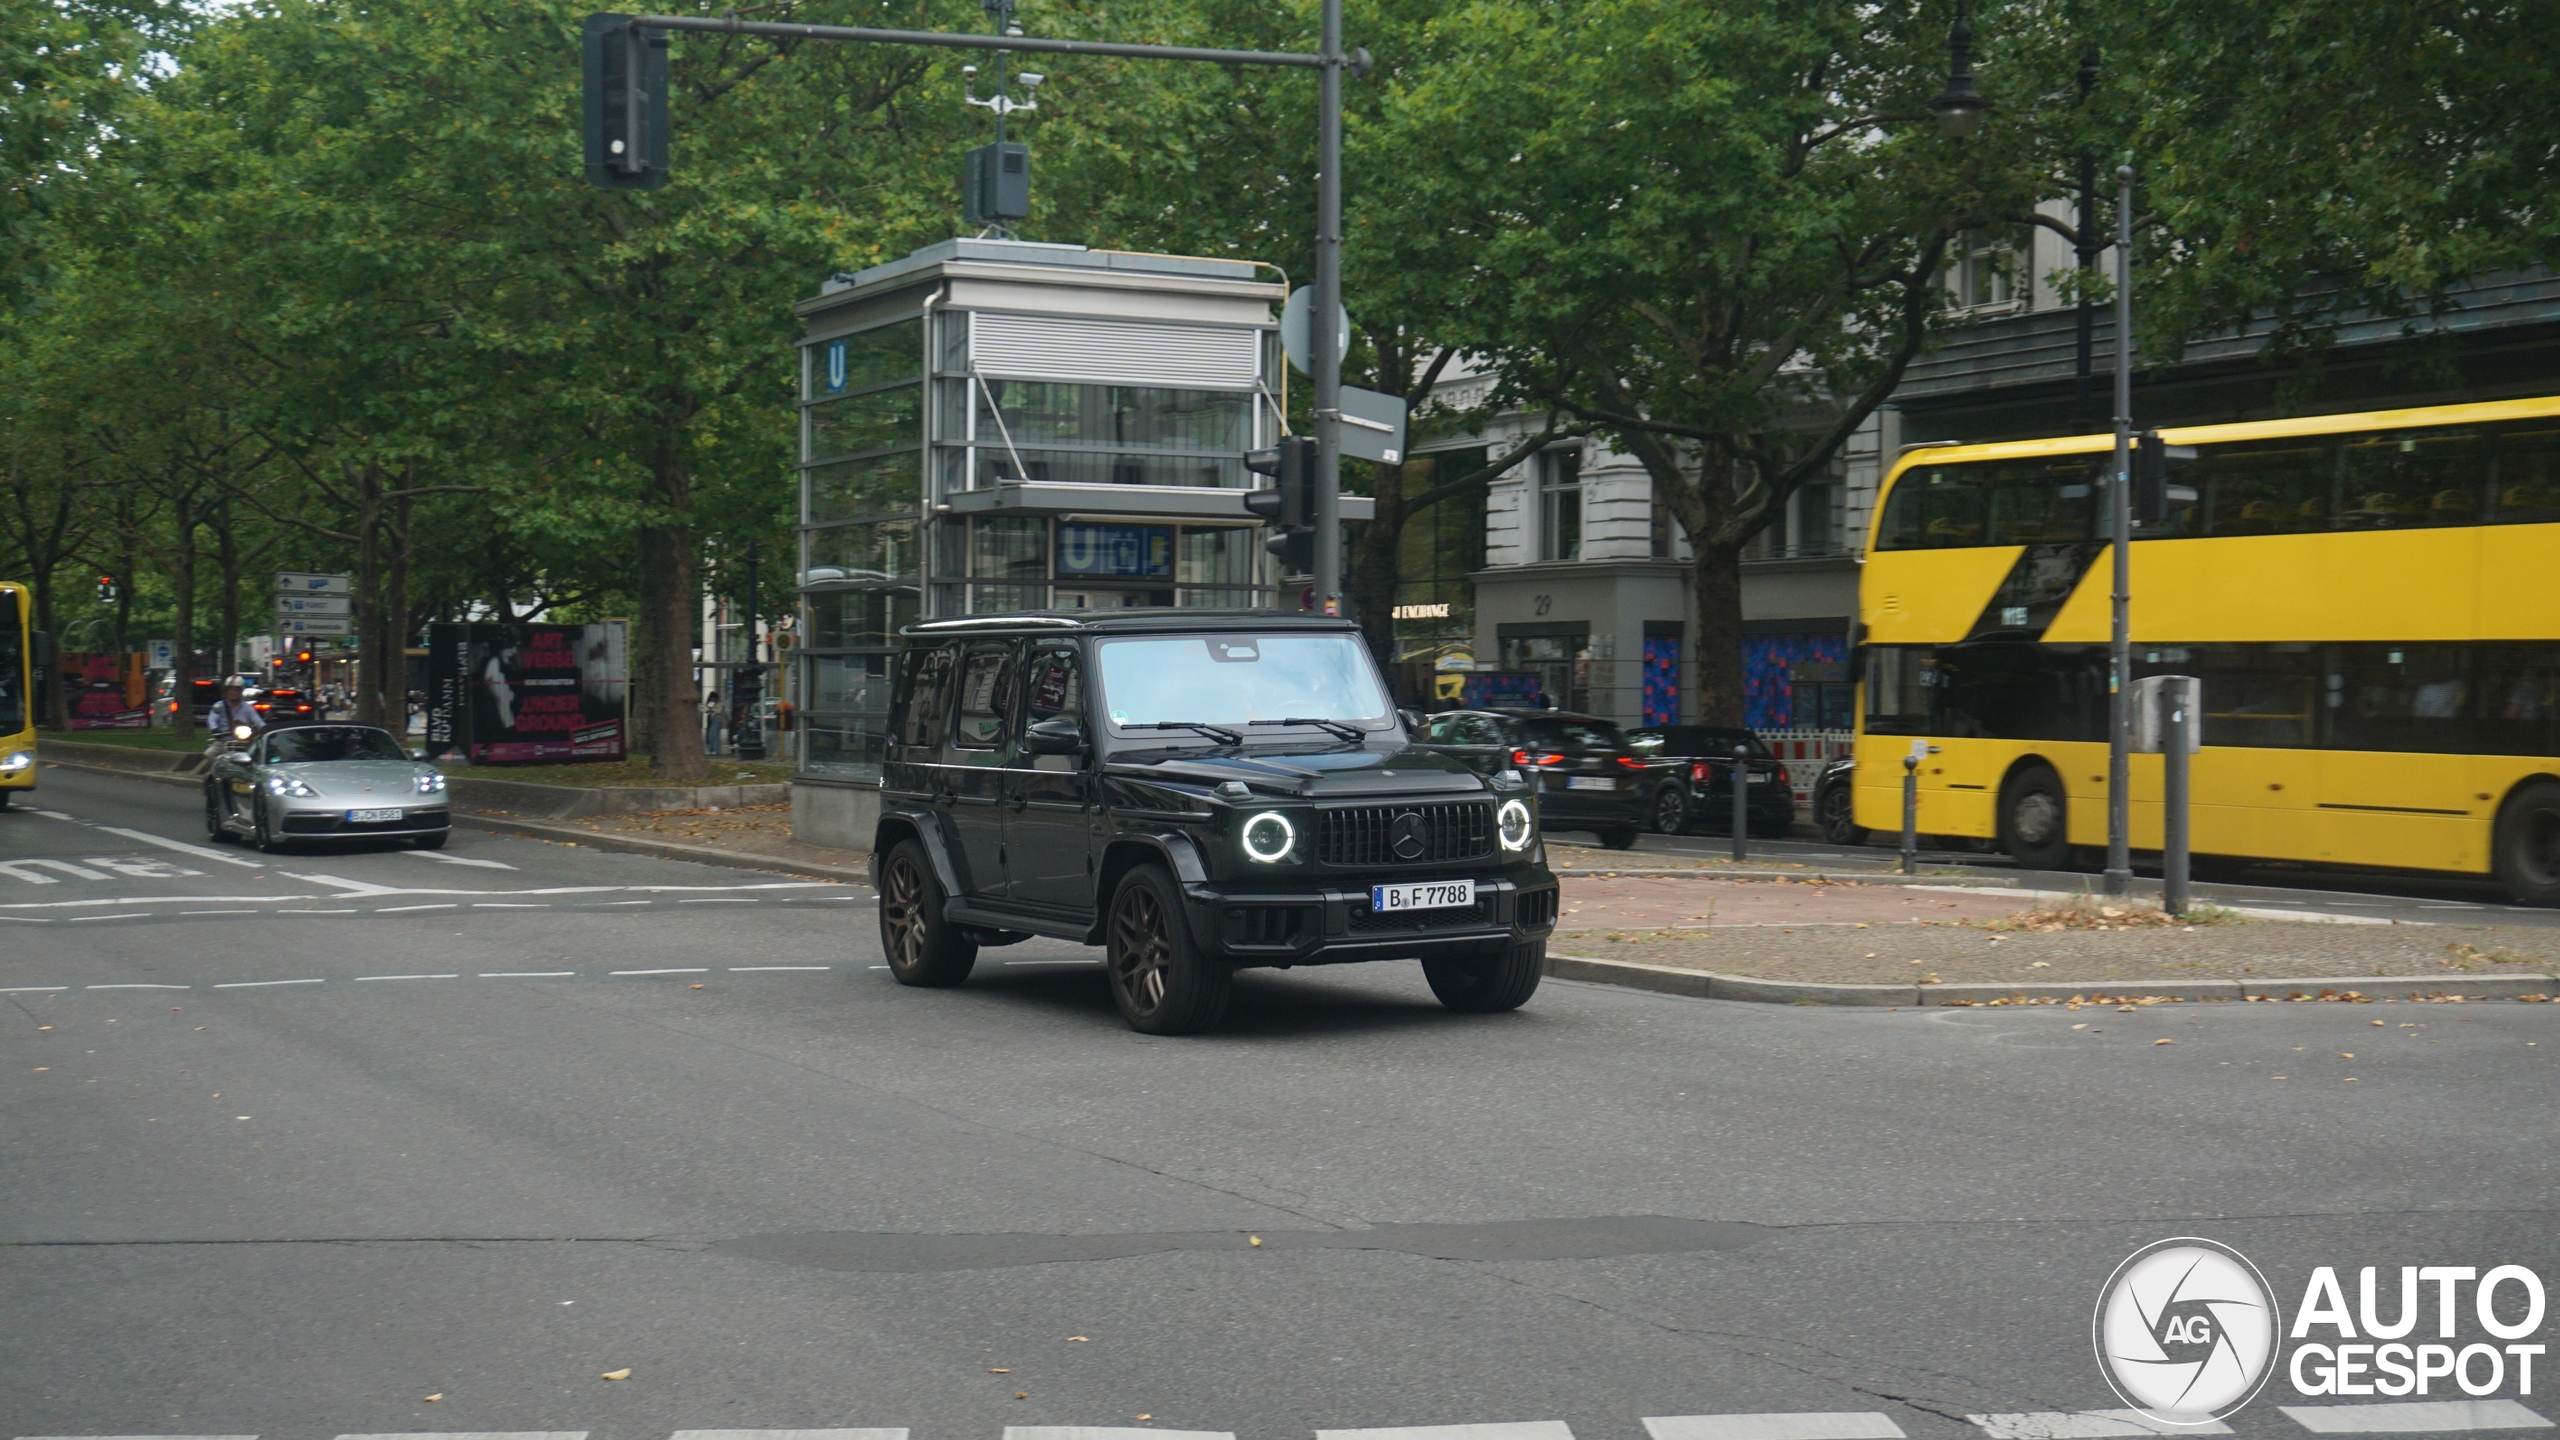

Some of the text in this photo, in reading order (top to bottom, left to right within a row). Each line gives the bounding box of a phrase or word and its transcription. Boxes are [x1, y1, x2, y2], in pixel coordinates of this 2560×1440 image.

[830, 344, 845, 388] U
[1064, 527, 1096, 570] U
[1402, 603, 1450, 618] EXCHANGE
[1535, 594, 1552, 615] 29
[0, 857, 214, 884] BU
[1390, 884, 1467, 908] B F 7788
